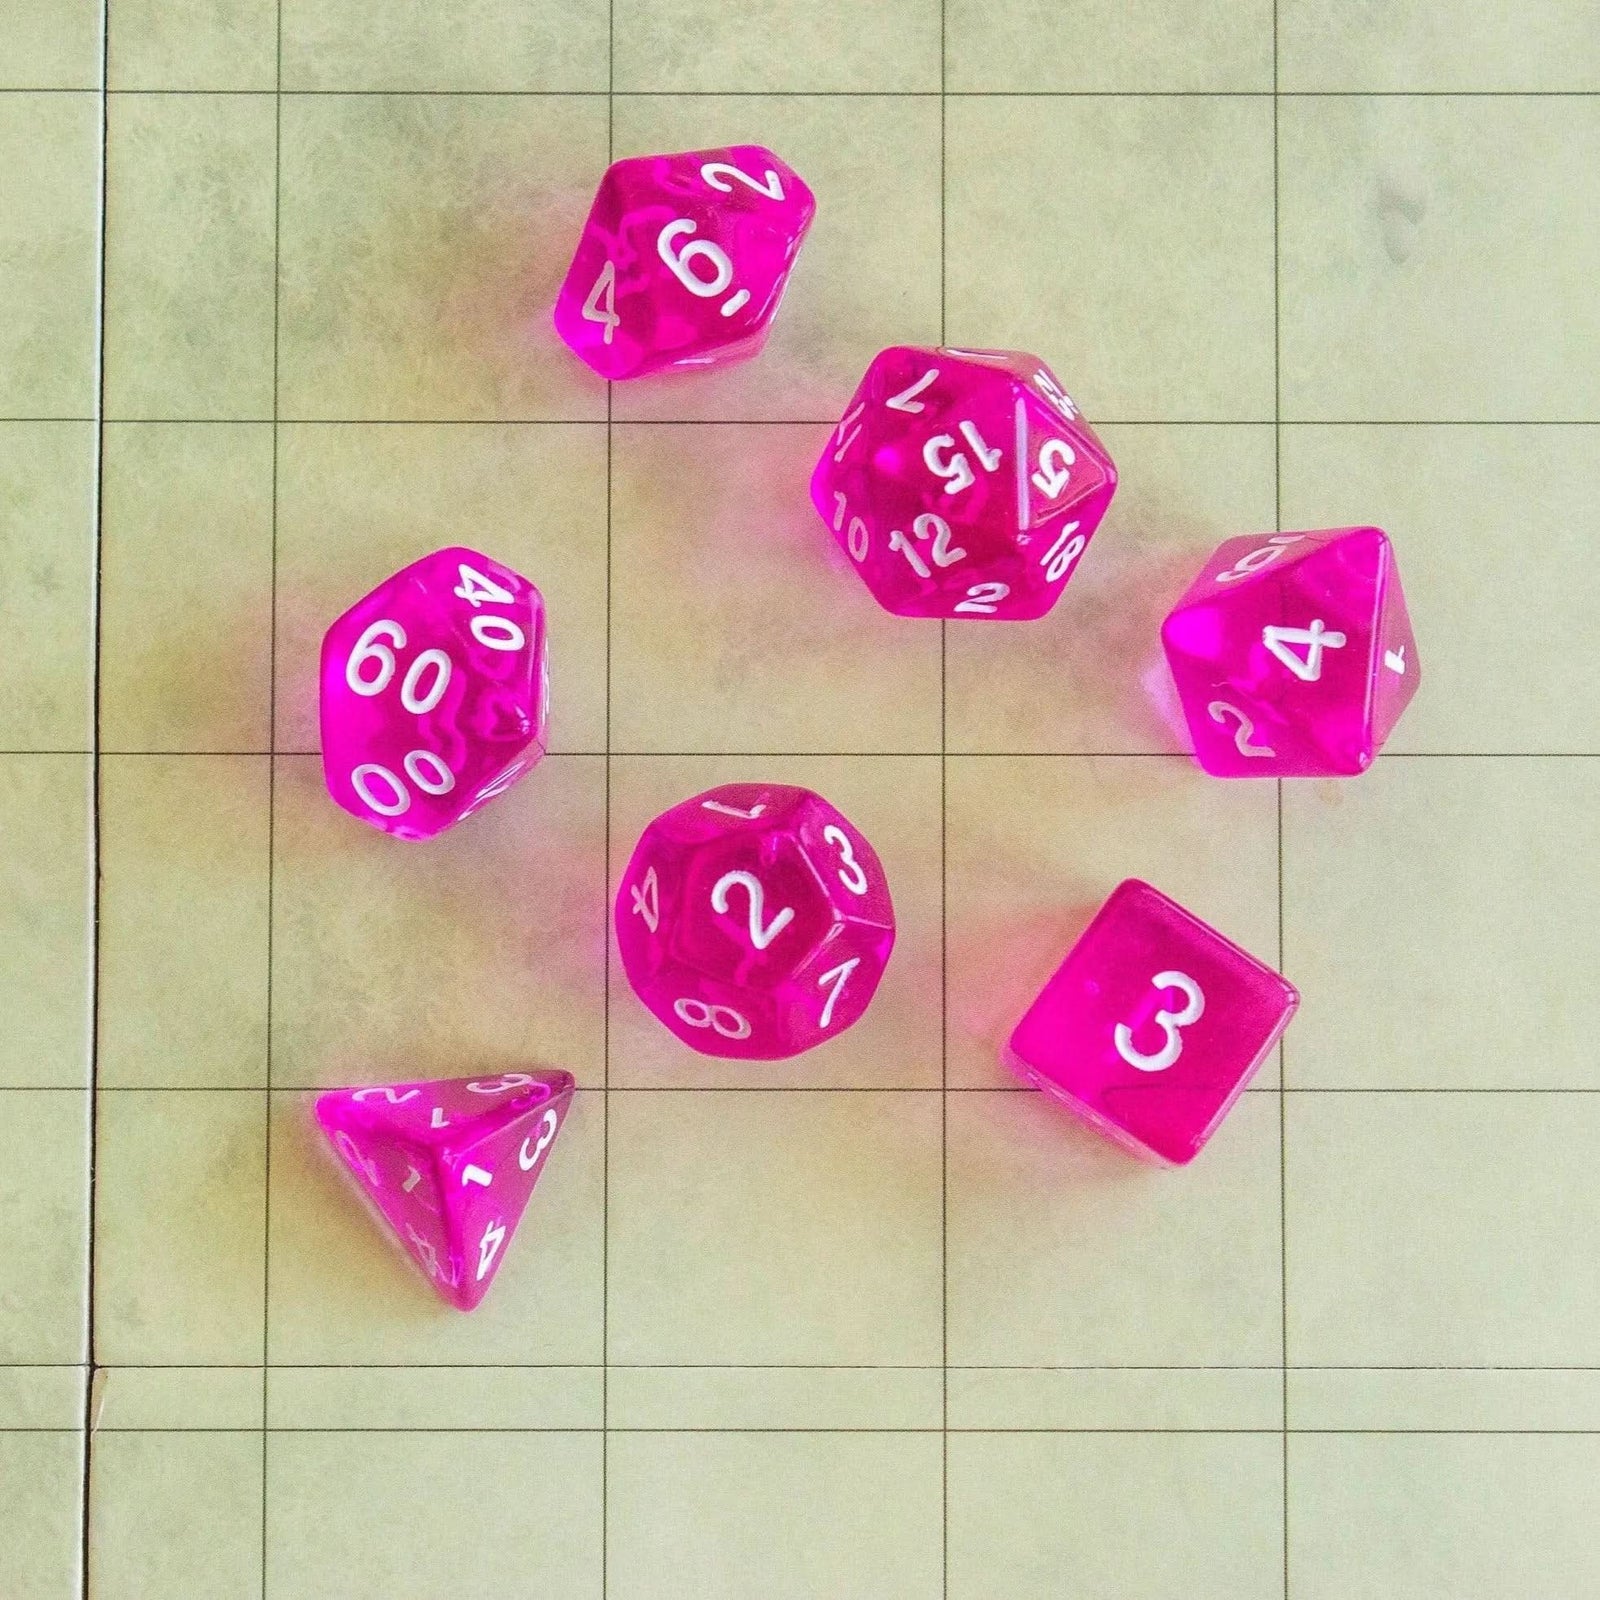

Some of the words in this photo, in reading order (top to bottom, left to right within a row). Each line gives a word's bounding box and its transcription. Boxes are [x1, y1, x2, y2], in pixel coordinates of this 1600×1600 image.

[701, 163, 785, 200] 2
[582, 260, 620, 344] 4
[923, 421, 1003, 494] 15
[1031, 439, 1076, 499] 5
[834, 491, 869, 562] 10
[888, 513, 967, 578] 12
[1040, 521, 1086, 582] 18
[454, 564, 525, 651] 40
[954, 583, 1010, 613] 2
[346, 619, 452, 714] 60
[1263, 619, 1346, 681] 4
[1207, 701, 1276, 758] 2
[351, 750, 455, 816] 00
[824, 825, 867, 895] 3
[631, 866, 659, 933] 4
[711, 870, 795, 950] 2
[674, 998, 752, 1040] 8
[1114, 970, 1205, 1072] 3
[519, 1109, 557, 1171] 3
[462, 1164, 493, 1187] 1
[476, 1221, 506, 1281] 4
